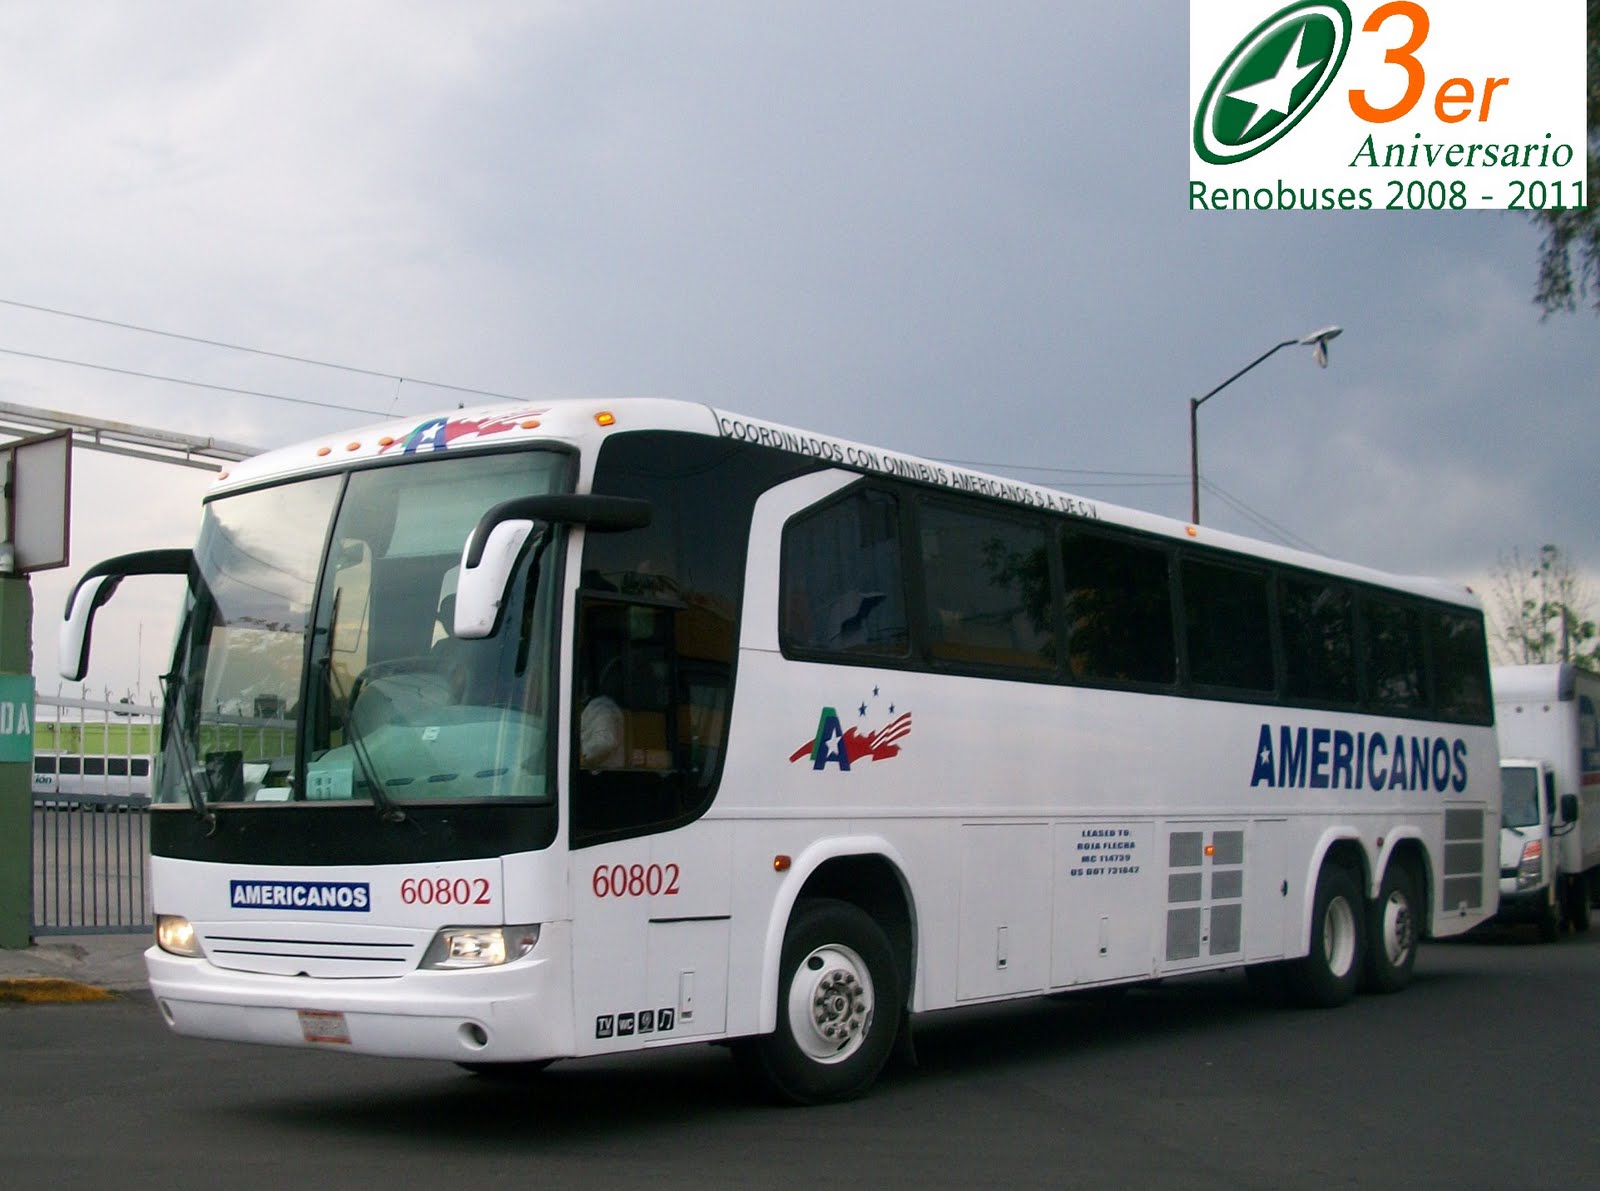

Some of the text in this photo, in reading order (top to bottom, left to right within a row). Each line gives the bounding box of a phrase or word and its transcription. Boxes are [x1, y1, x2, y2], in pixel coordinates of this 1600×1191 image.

[720, 417, 844, 463] COORDINADOS
[846, 446, 880, 470] CON
[883, 455, 948, 485] OMNIBUS
[952, 472, 1034, 505] AMERICANOS
[1250, 724, 1468, 793] AMERICANOS
[233, 885, 368, 907] AMERICANOS
[401, 878, 492, 905] 60802
[592, 863, 680, 898] 60802
[598, 1017, 612, 1031] TV
